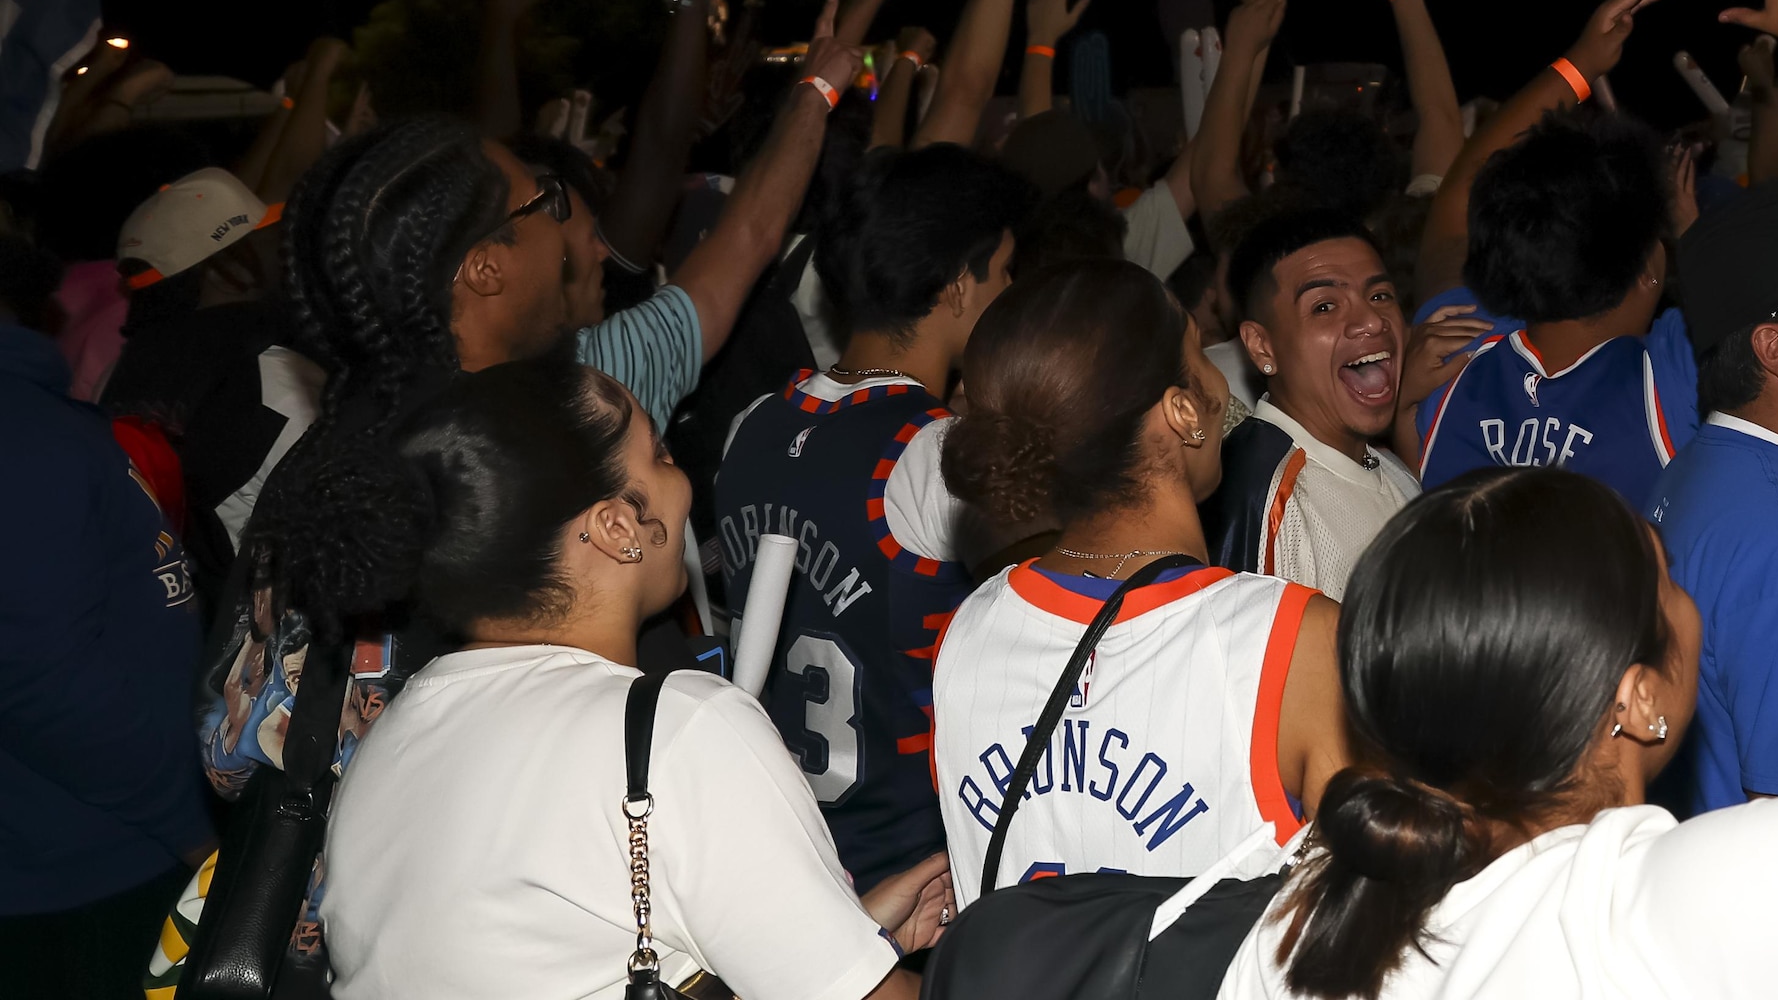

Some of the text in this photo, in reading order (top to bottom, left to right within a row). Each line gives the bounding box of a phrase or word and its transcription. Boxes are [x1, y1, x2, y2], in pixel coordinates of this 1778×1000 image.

[211, 222, 231, 242] NEW
[719, 503, 873, 618] OBINSON
[958, 719, 1210, 853] BRUNSON
